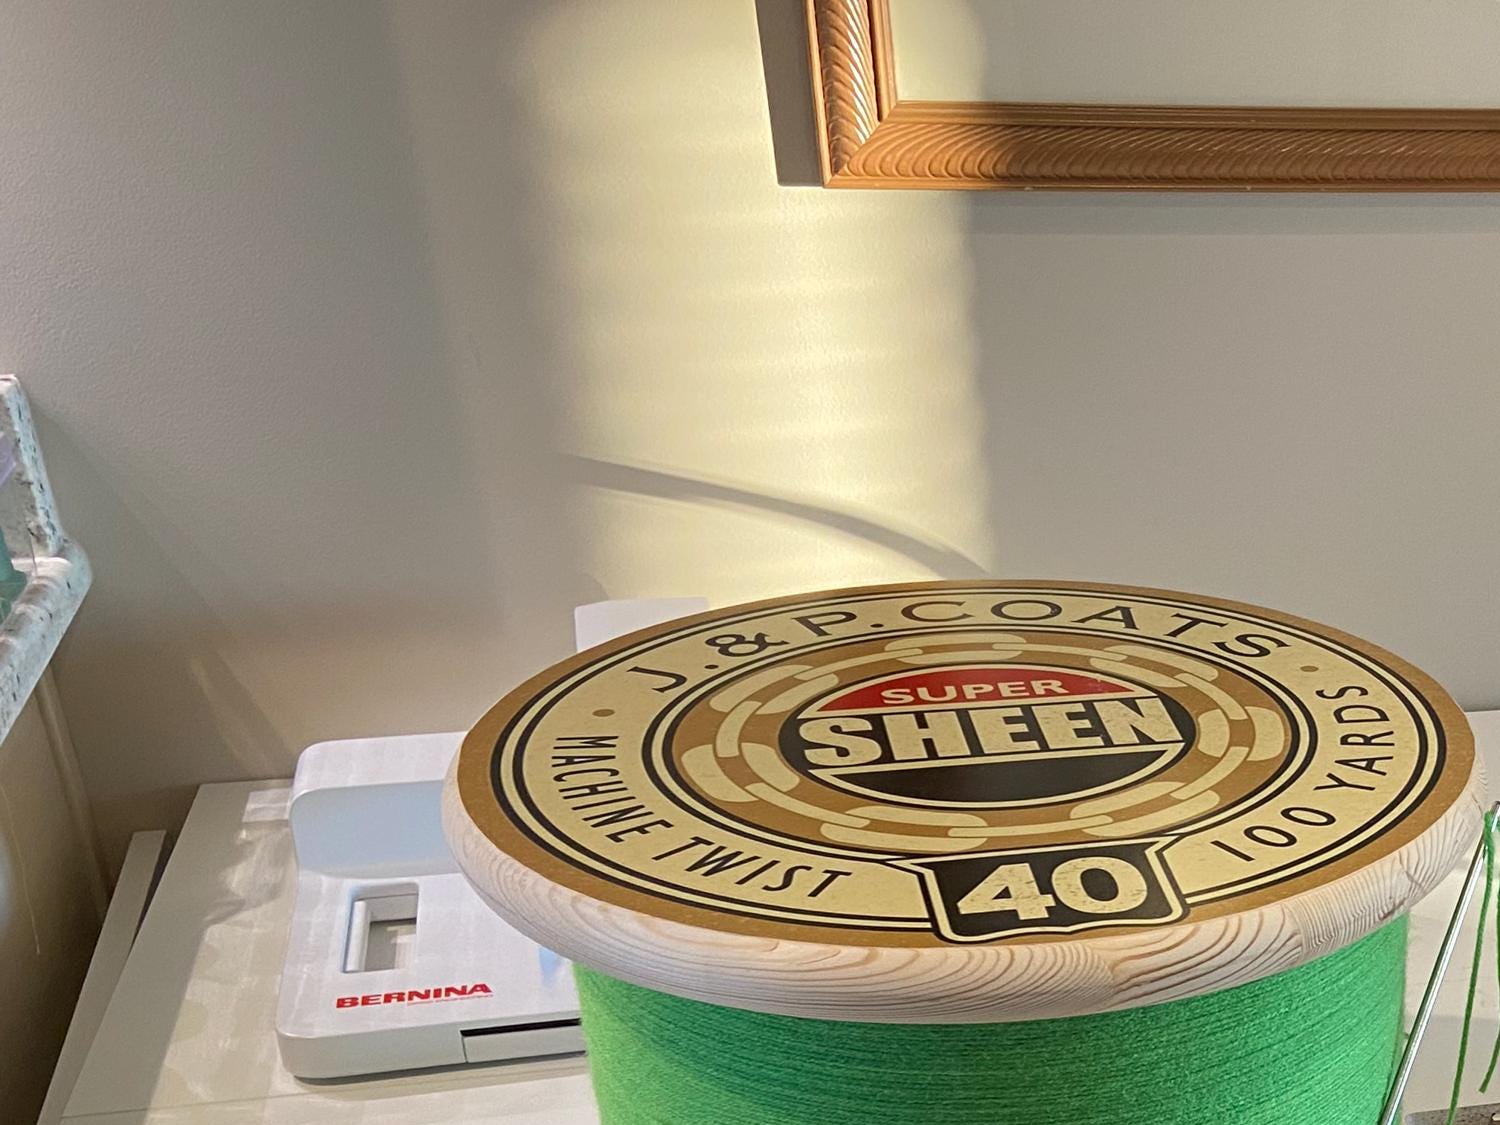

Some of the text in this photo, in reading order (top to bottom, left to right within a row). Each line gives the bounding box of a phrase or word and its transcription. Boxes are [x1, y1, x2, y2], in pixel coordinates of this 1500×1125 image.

[880, 679, 1069, 705] SUPER
[798, 696, 1184, 767] SHEEN
[1211, 685, 1397, 862] 100 YARDS
[552, 735, 854, 898] MACHINE TWIST
[957, 856, 1150, 921] 40
[336, 983, 493, 1009] BERNINA
